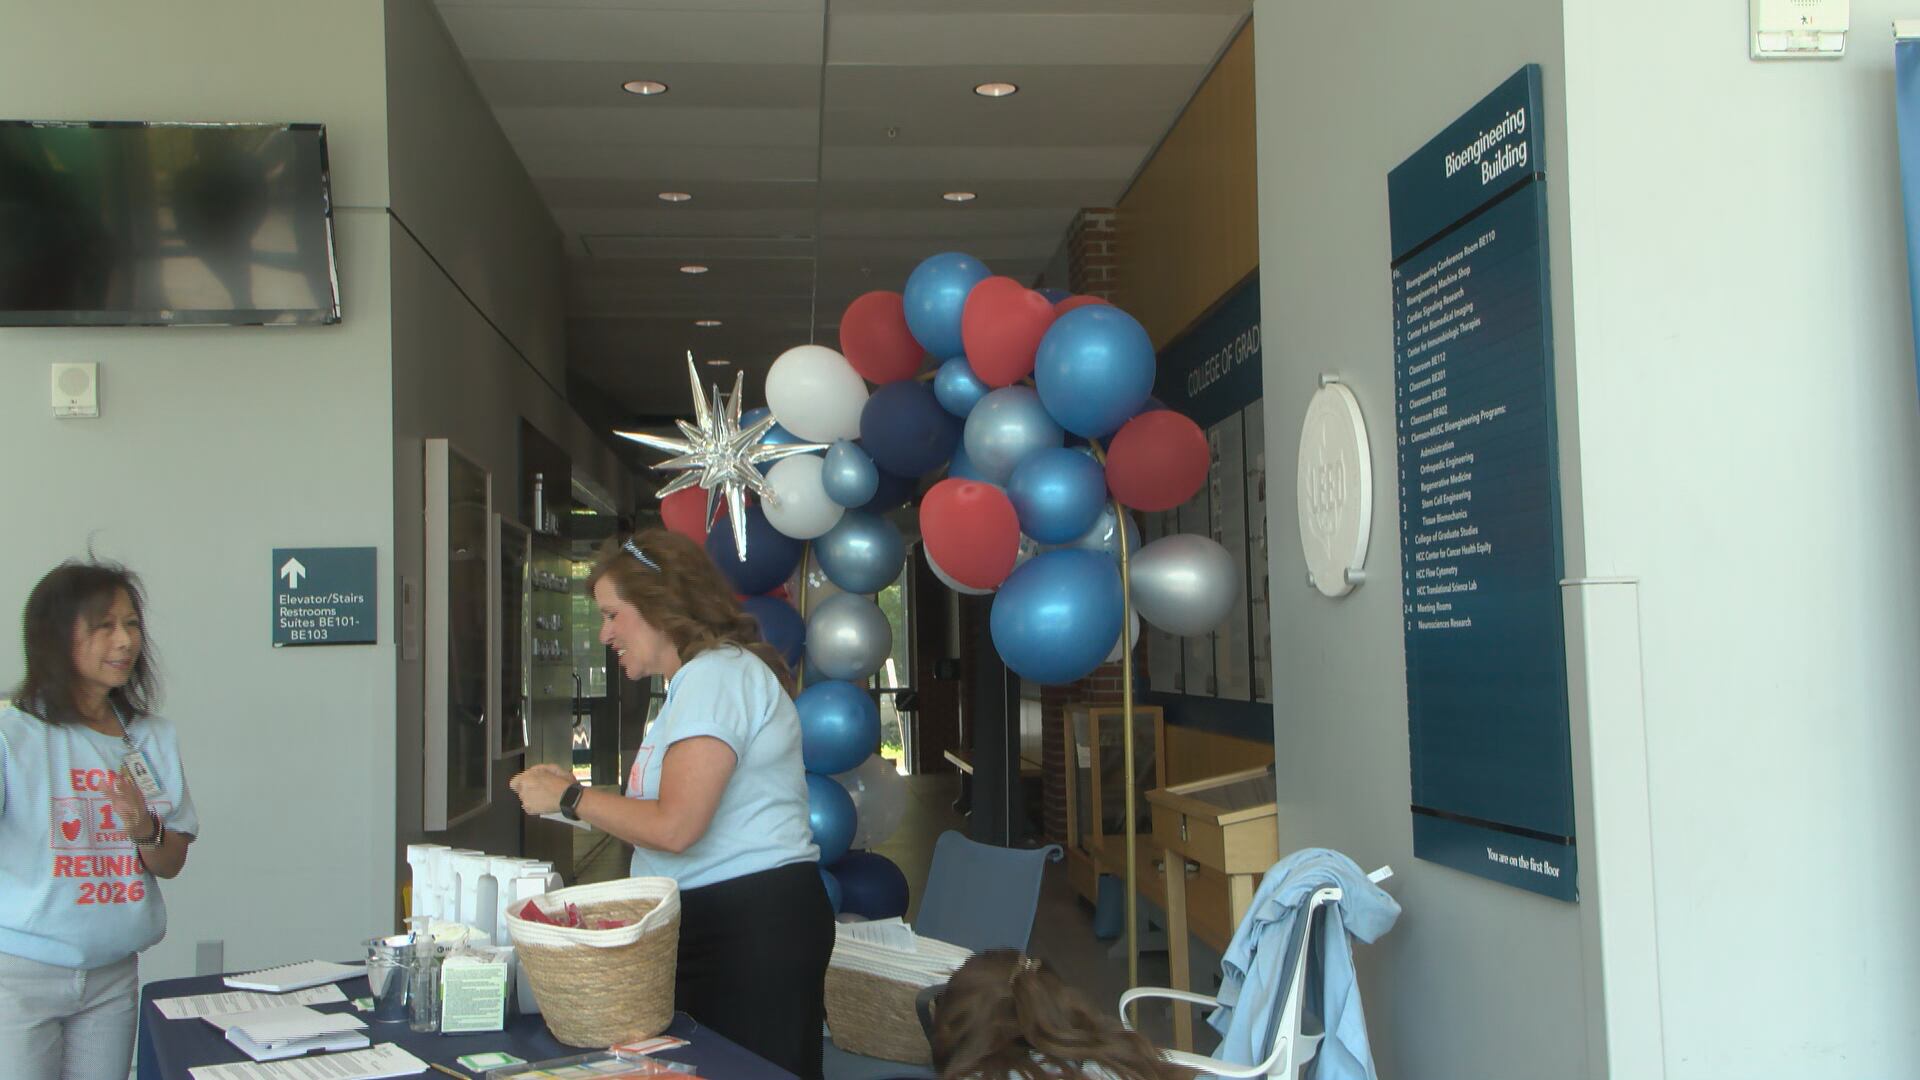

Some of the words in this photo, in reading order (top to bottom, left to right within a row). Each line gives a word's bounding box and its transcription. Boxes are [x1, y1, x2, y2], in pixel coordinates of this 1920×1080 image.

[1445, 107, 1526, 179] Bioengineering
[1481, 141, 1527, 185] Building
[1406, 266, 1437, 290] Bioengineering
[1437, 251, 1464, 271] Conference
[1464, 243, 1478, 257] Room
[1478, 230, 1496, 248] BE110
[1406, 284, 1438, 307] Bioengineering
[1438, 273, 1458, 289] Machine
[1458, 266, 1471, 280] Shop
[1407, 311, 1423, 324] Cardiac
[1423, 300, 1443, 317] Signaling
[1443, 287, 1464, 305] Research
[1407, 329, 1422, 341] Center
[1429, 310, 1454, 331] Biomedical
[1453, 302, 1474, 318] Imaging
[1407, 347, 1421, 358] Center
[1459, 318, 1481, 333] Therapies
[1187, 353, 1221, 398] COLLEGE
[1221, 343, 1233, 374] OF
[1234, 324, 1260, 364] GRAD
[1409, 361, 1431, 376] Classroom
[1431, 352, 1446, 367] BE112
[1409, 377, 1432, 393] Classroom
[1409, 395, 1432, 410] Classroom
[1410, 412, 1433, 426] Classroom
[1411, 423, 1444, 443] Clemson-MUSC
[1444, 412, 1480, 432] Bioengineering
[1420, 441, 1455, 458] Administration
[1445, 452, 1474, 468] Engineering
[1420, 478, 1450, 493] Regenerative
[1449, 471, 1471, 483] Medicine
[1421, 498, 1434, 509] Stem
[1433, 495, 1443, 506] Cell
[1443, 490, 1471, 506] Engineering
[1422, 516, 1436, 526] Tissue
[1436, 508, 1468, 523] Biomechanics
[1415, 534, 1432, 545] College
[1432, 531, 1438, 541] of
[1437, 529, 1460, 540] Graduate
[1460, 525, 1478, 537] Studies
[1415, 552, 1426, 562] HCC
[1425, 551, 1440, 560] Center
[1446, 547, 1461, 557] Cancer
[1461, 544, 1476, 555] Health
[1476, 542, 1492, 556] Equity
[1415, 569, 1426, 579] HCC
[1425, 568, 1436, 578] Flow
[1436, 566, 1458, 579] Cytometry
[1416, 586, 1426, 596] HCC
[1426, 584, 1451, 595] Translational
[1451, 582, 1468, 593] Science
[1468, 579, 1478, 591] Lab
[279, 592, 364, 605] Elevator/Stairs
[1417, 604, 1436, 615] Meeting
[1435, 602, 1452, 611] Rooms
[280, 607, 337, 617] Restrooms
[280, 618, 315, 628] Suites
[319, 616, 360, 627] BE101-
[1418, 619, 1450, 630] Neurosciences
[1450, 617, 1472, 628] Research
[291, 629, 328, 641] BE103
[98, 803, 116, 830] 1
[1487, 847, 1498, 862] You
[1498, 853, 1508, 865] are
[1509, 856, 1517, 867] on
[1518, 854, 1529, 870] the
[1530, 857, 1543, 875] first
[1543, 861, 1560, 878] floor
[76, 879, 146, 906] 2026
